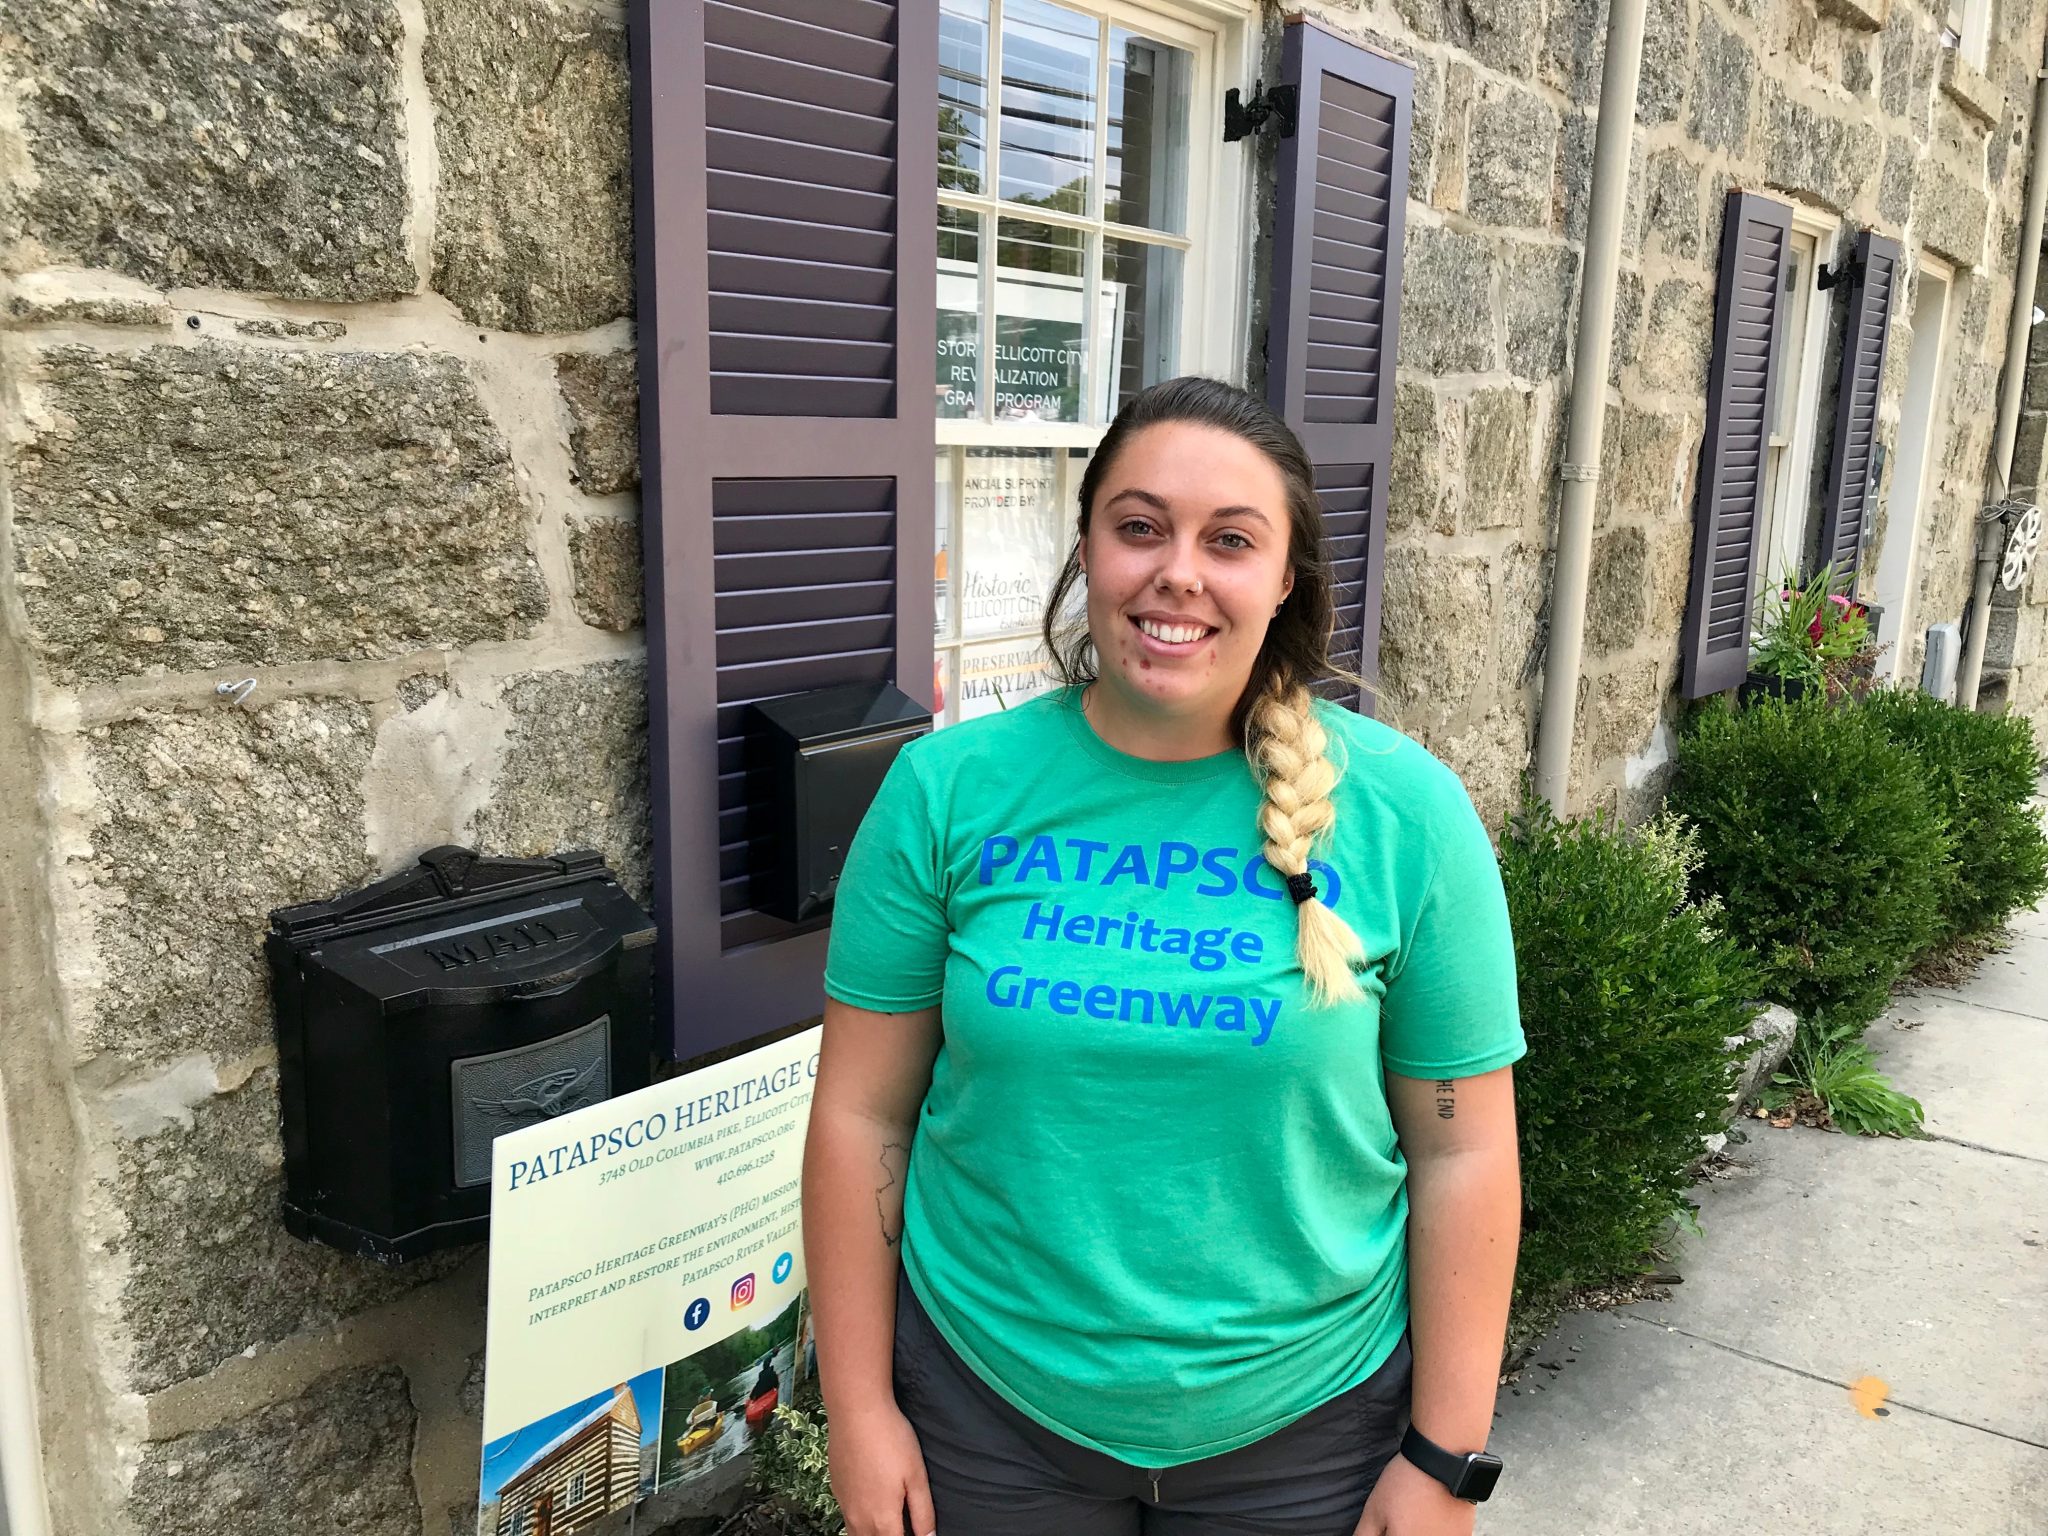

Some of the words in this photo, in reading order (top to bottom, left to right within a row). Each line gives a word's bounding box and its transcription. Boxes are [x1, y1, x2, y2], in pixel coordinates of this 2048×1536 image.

[937, 340, 976, 357] STOR
[994, 345, 1055, 363] ELLICOTT
[945, 390, 975, 405] GRA
[996, 393, 1061, 409] PROGRAM
[965, 478, 1002, 489] ANCIAL
[963, 570, 1031, 598] Historic
[424, 923, 578, 971] MAIL
[1022, 902, 1264, 971] Heritage
[985, 965, 1283, 1047] Greenway
[1436, 1079, 1455, 1093] HE
[1437, 1098, 1455, 1119] END
[509, 1113, 667, 1191] PATAPSCO
[674, 1061, 801, 1132] HERITAGE
[808, 1053, 819, 1078] G
[598, 1164, 627, 1186] 3748
[628, 1156, 654, 1173] OLD
[656, 1133, 715, 1163] COLUMBIA
[716, 1122, 742, 1141] PIKE,
[744, 1102, 789, 1129] ELLICOTT
[694, 1120, 796, 1171] WWW.PATAPSCO.ORG
[716, 1150, 776, 1186] 410.696.1328
[528, 1269, 592, 1302] PATAPSCO
[594, 1243, 656, 1276] HERITAGE
[729, 1196, 760, 1222] (PHG)
[761, 1177, 799, 1205] MISSION
[528, 1289, 598, 1326] INTERPRET
[600, 1278, 626, 1297] AND
[628, 1257, 680, 1285] RESTORE
[682, 1246, 705, 1264] THE
[780, 1197, 802, 1216] HIST
[682, 1254, 734, 1286] PATAPSCO
[735, 1239, 765, 1262] RIVER
